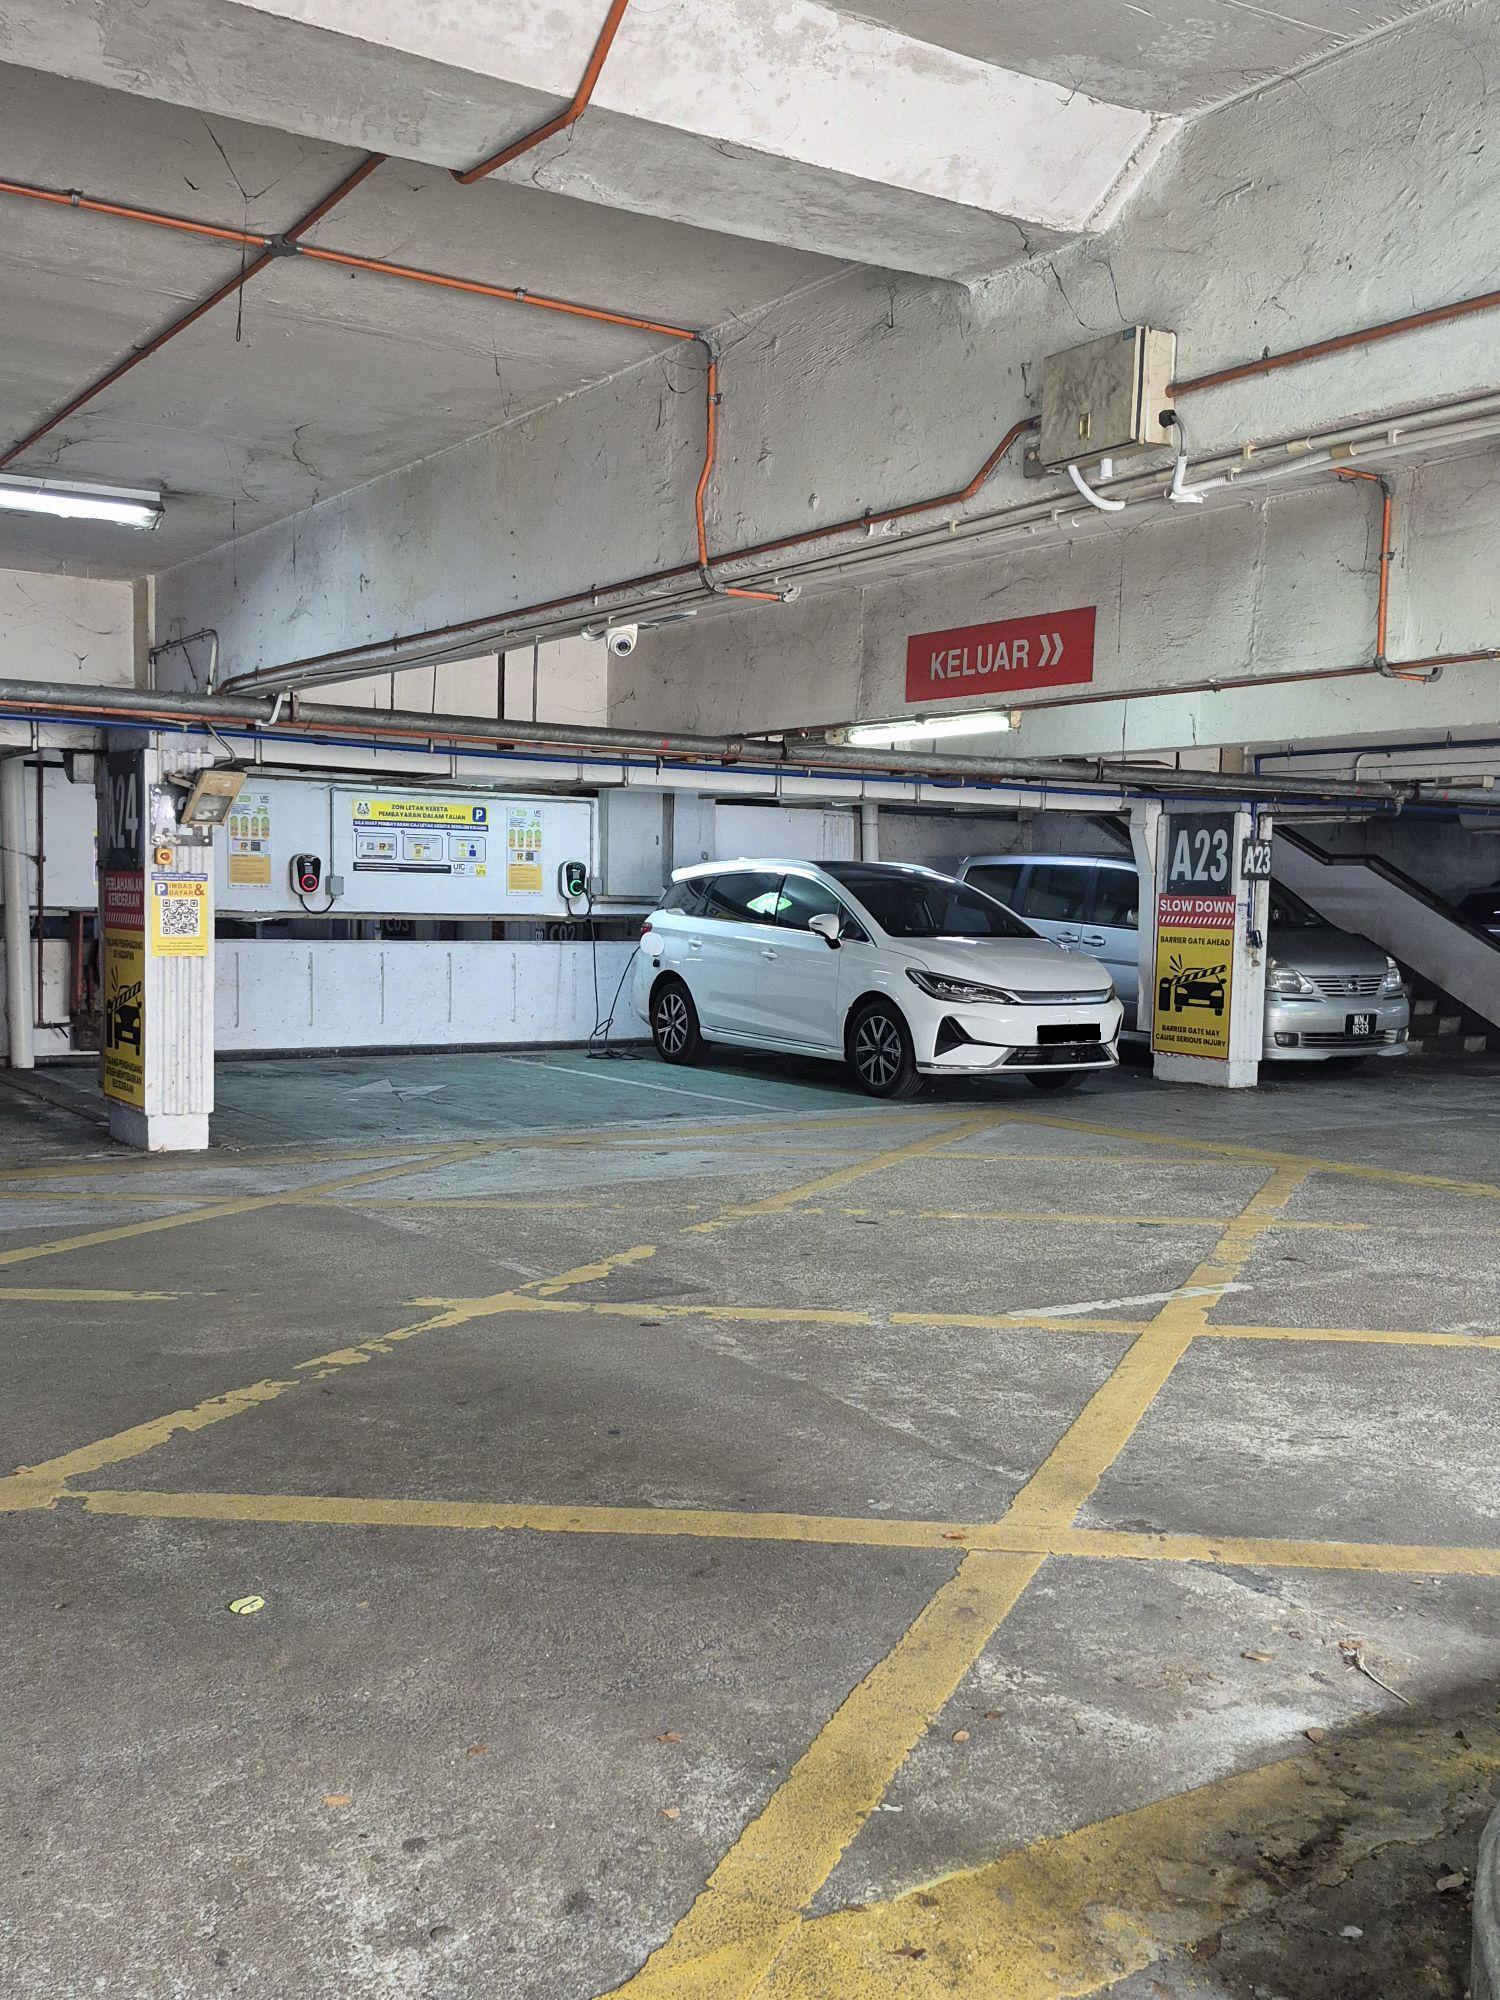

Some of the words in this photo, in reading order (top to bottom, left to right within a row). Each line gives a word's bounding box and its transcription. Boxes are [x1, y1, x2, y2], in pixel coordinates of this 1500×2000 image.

[930, 639, 1030, 680] KELUAR
[378, 810, 422, 818] PEMBAYARAN
[475, 810, 484, 820] P
[1169, 829, 1228, 882] A23
[1244, 845, 1271, 874] A23
[157, 883, 166, 895] P
[194, 884, 205, 896] &
[1160, 899, 1193, 912] SLOW
[1195, 901, 1235, 913] DOWN
[1160, 936, 1187, 945] BARRIER
[1187, 937, 1206, 945] GATE
[1206, 938, 1231, 947] AHEAD
[1354, 1014, 1369, 1025] WNJ
[1161, 1024, 1187, 1033] BARRIER
[1187, 1027, 1204, 1035] GATE
[1205, 1028, 1220, 1037] MAY
[1352, 1024, 1369, 1035] 1633
[1155, 1033, 1175, 1042] CAUSE
[1176, 1035, 1202, 1044] SERIOUS
[1202, 1038, 1226, 1047] INJURY
